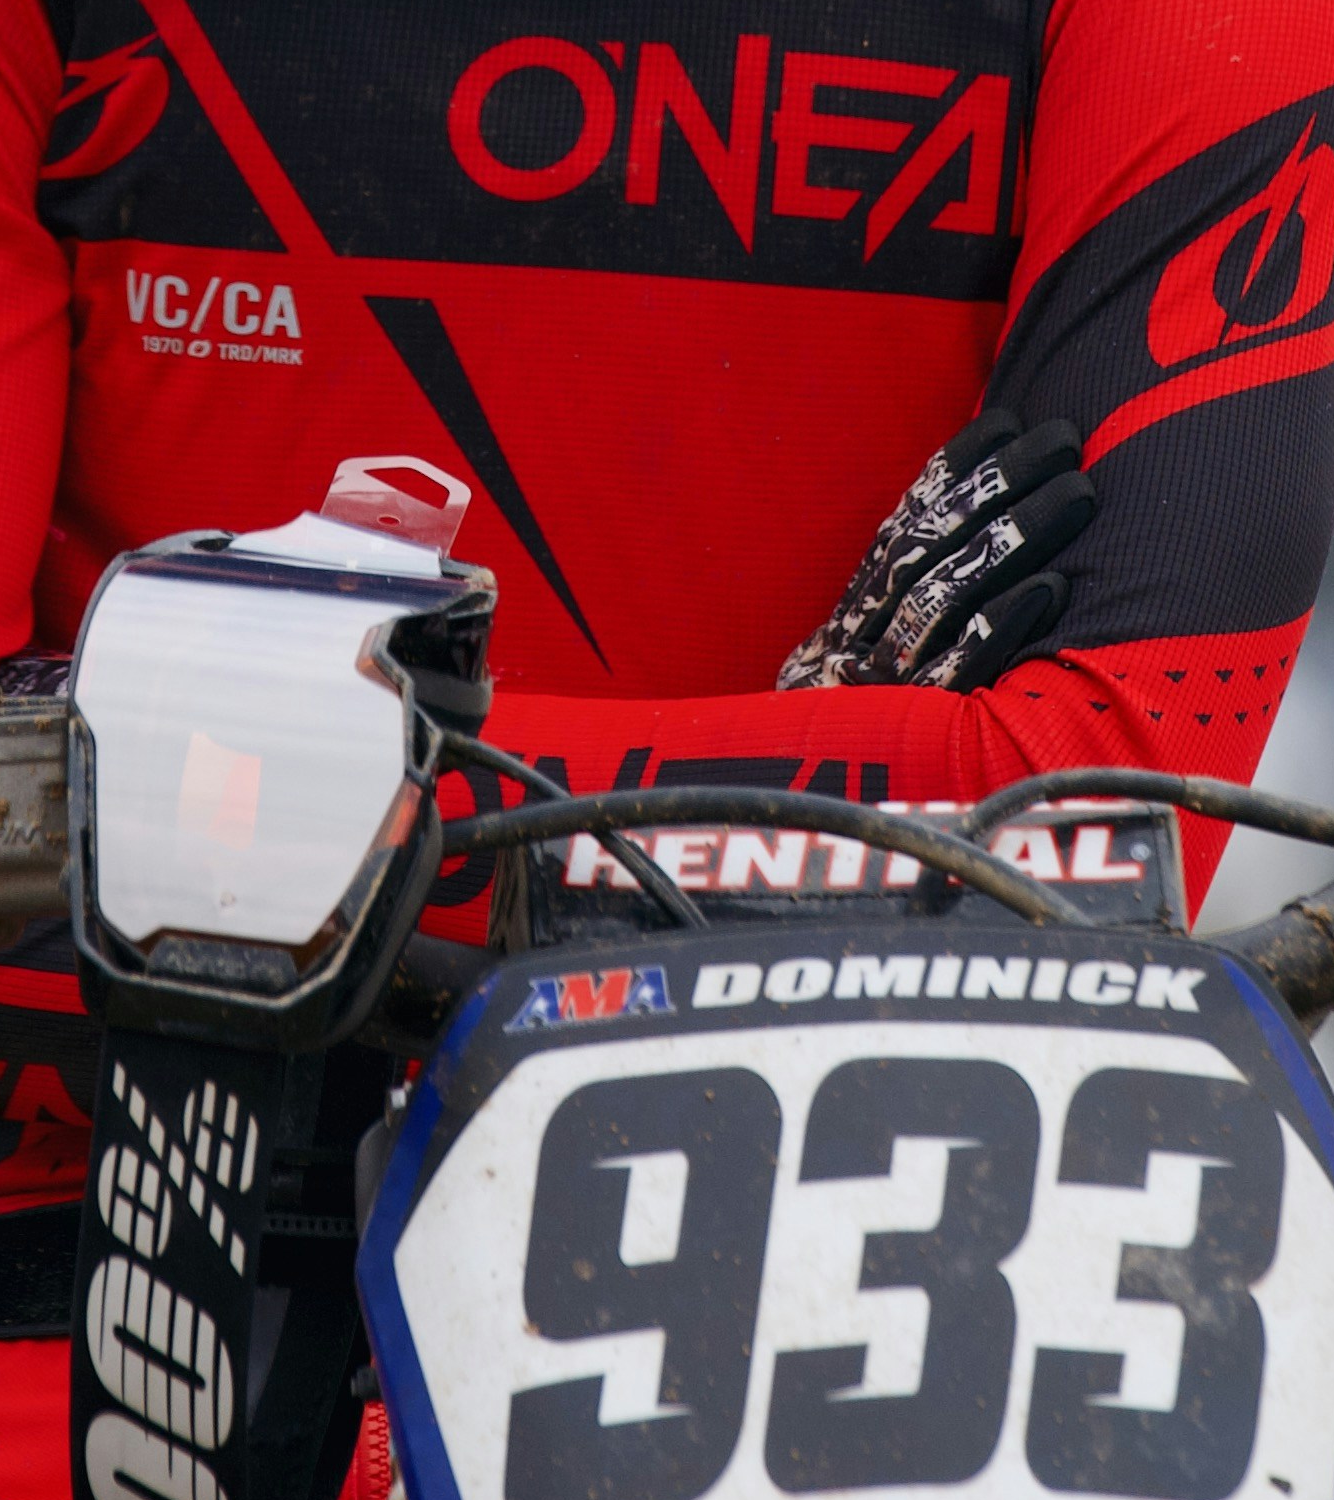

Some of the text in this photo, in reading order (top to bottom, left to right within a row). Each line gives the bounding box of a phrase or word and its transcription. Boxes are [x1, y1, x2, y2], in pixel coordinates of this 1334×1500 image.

[446, 32, 1025, 264] O'NEA
[126, 268, 302, 338] VC/CA
[141, 334, 304, 366] 1970 TRD/MRK
[503, 955, 1208, 1035] AMA DOMINICK
